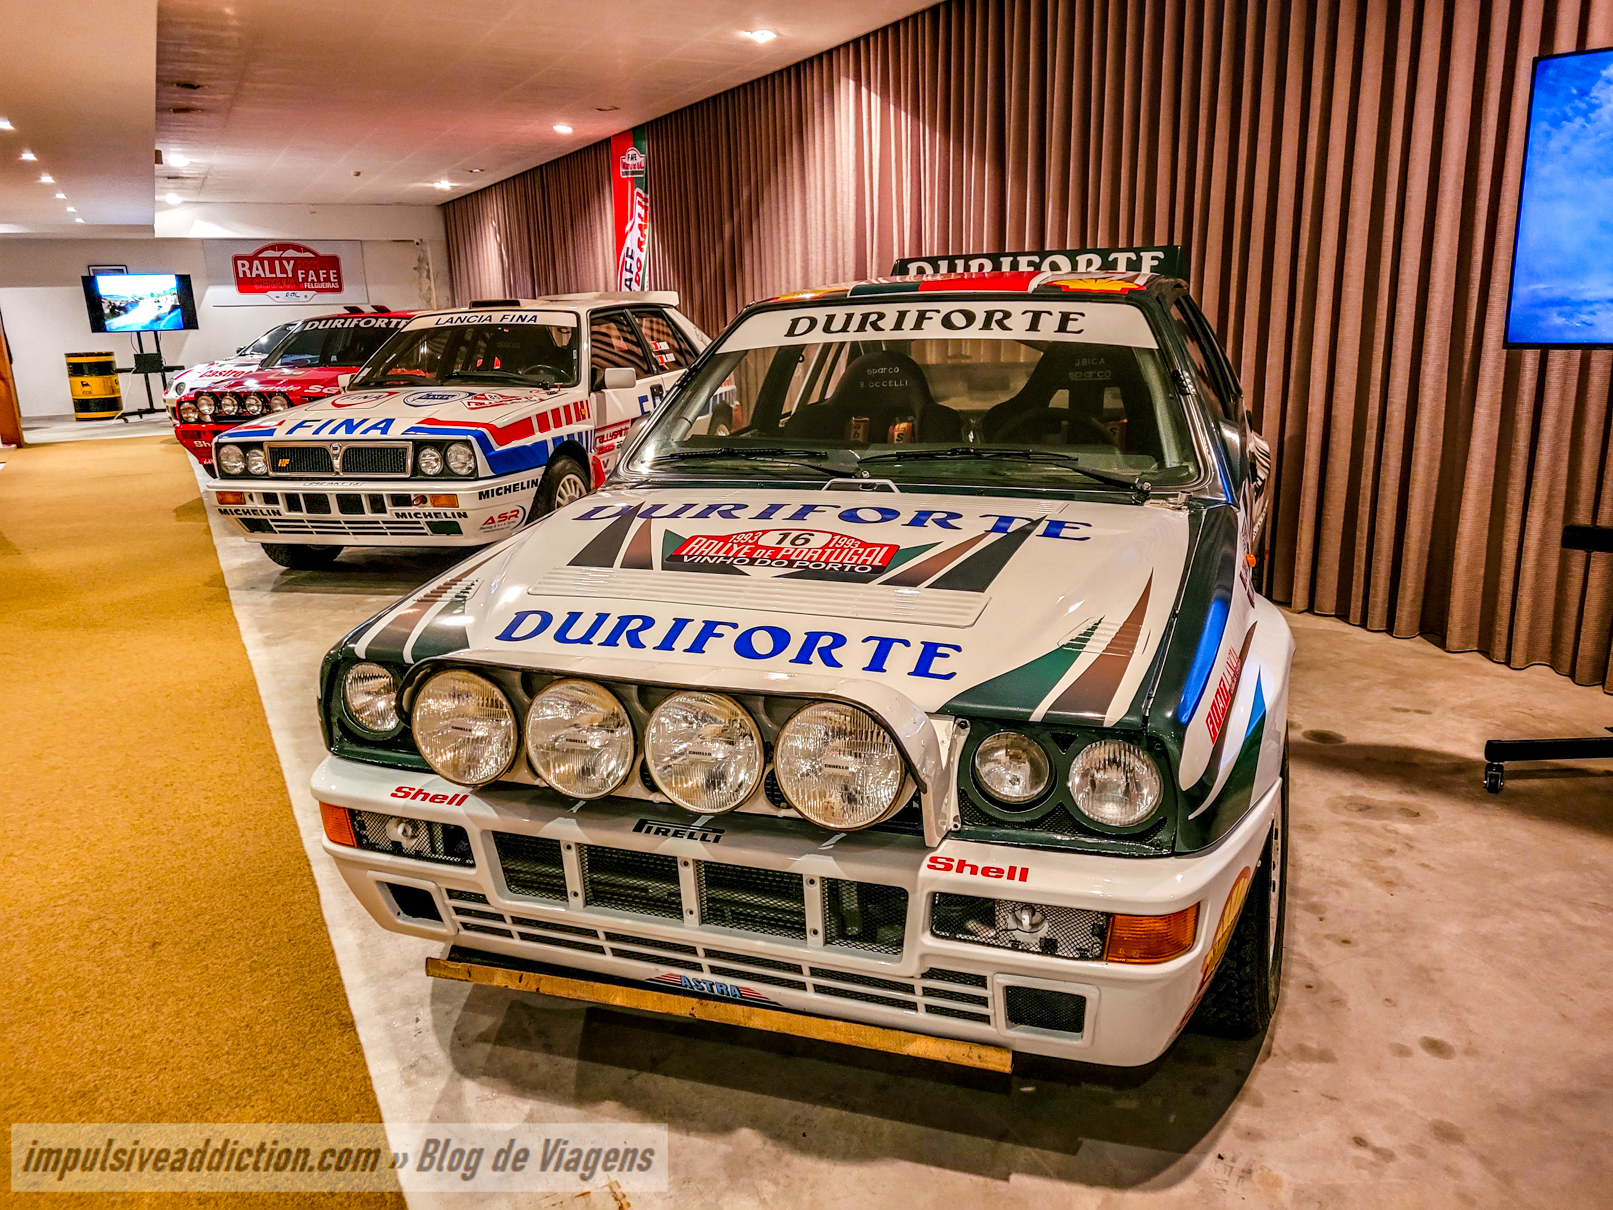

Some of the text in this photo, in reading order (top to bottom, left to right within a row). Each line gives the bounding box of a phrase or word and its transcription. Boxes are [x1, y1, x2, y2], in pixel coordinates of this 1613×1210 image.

[237, 260, 294, 278] RALLY
[297, 269, 339, 283] FAFE
[624, 246, 635, 291] AFE
[434, 314, 538, 326] LANCIA FINA
[783, 308, 1086, 338] DURIFORTE
[199, 369, 246, 379] Castro
[868, 380, 908, 388] OCCELLI
[285, 418, 396, 436] FINA
[193, 440, 213, 448] Sh
[478, 478, 539, 501] MICHELIN
[218, 508, 283, 517] MICHELIN
[394, 511, 469, 519] MICHELIN
[482, 509, 520, 526] ASR
[571, 502, 1092, 542] DURIFORTE
[728, 531, 861, 549] 1993 16 1993
[686, 537, 752, 557] RALLYE
[777, 546, 889, 566] PORTUGAL
[682, 555, 872, 573] VINHO DO PORTO
[496, 609, 965, 681] DURIFORTE
[391, 784, 469, 807] Shell
[632, 818, 726, 844] PIRELLI
[926, 855, 1029, 883] Shell
[680, 975, 743, 998] ASTRA
